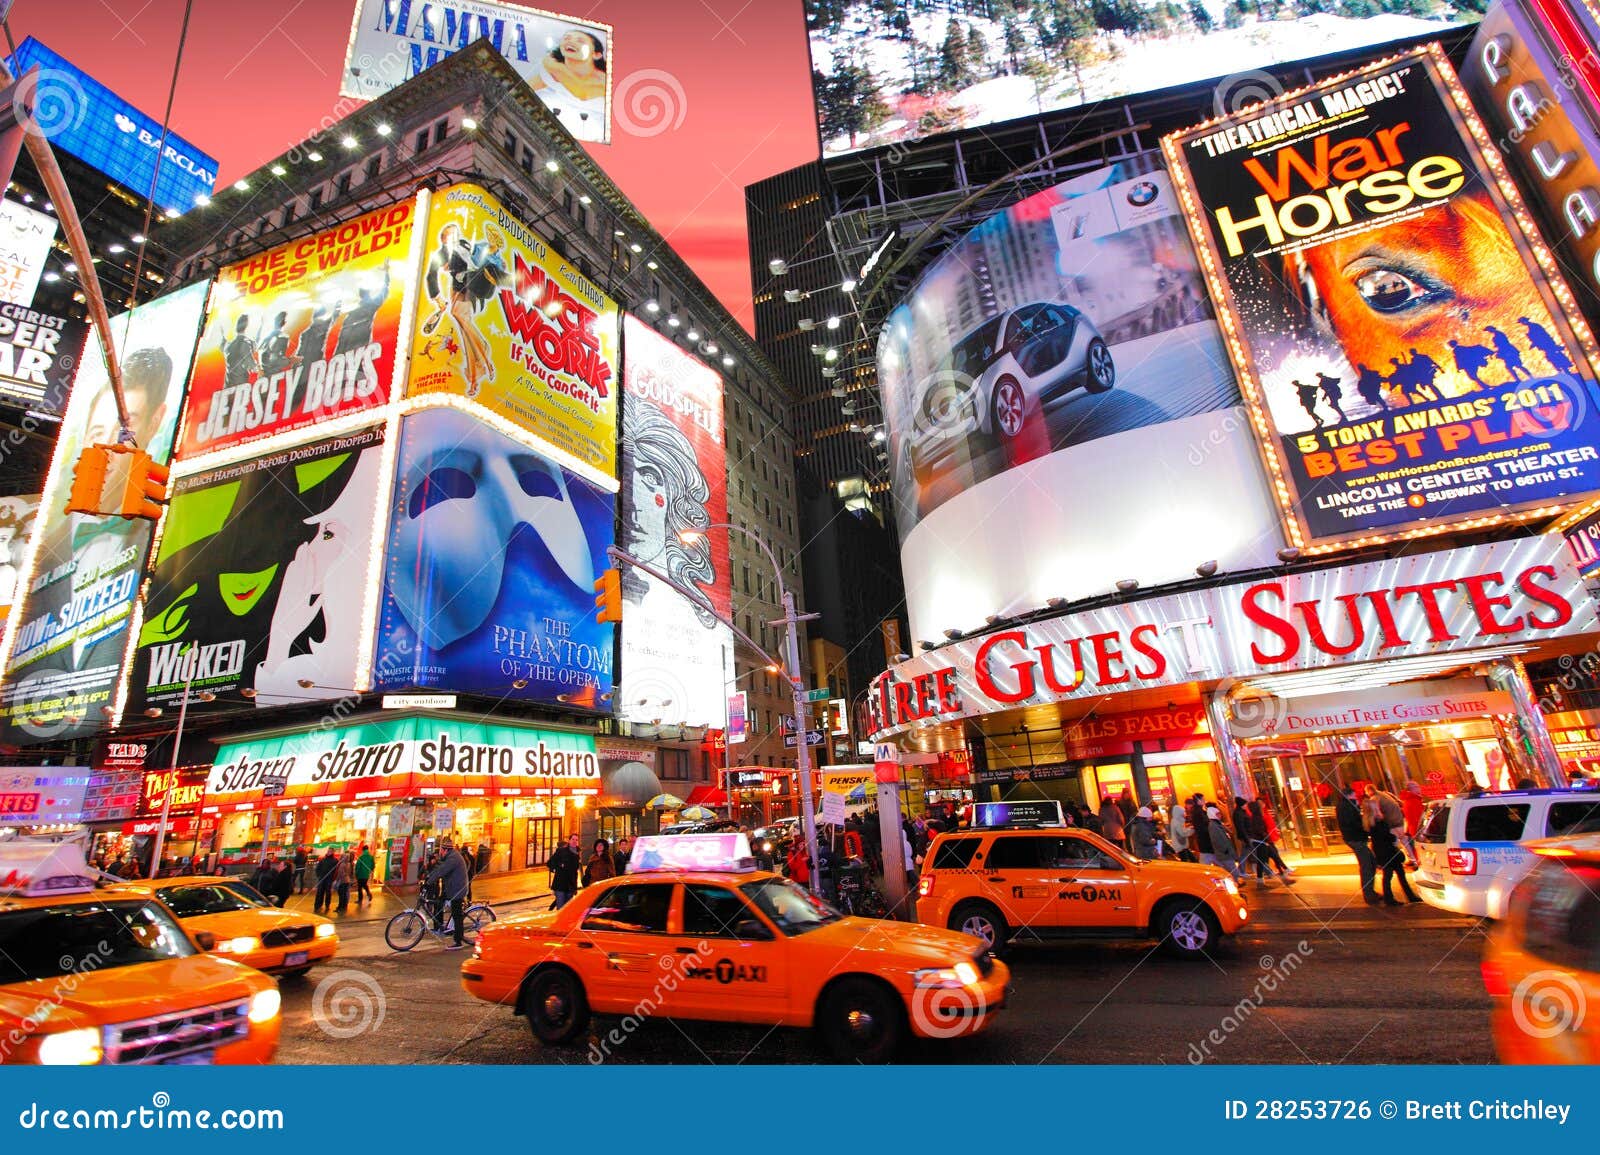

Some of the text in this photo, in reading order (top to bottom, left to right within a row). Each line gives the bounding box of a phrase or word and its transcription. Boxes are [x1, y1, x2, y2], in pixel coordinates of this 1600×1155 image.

[374, 0, 530, 62] MAMMA
[1242, 121, 1412, 203] War
[294, 204, 410, 261] CROWD
[498, 208, 546, 262] BRODERICK
[1215, 154, 1465, 257] Horse
[235, 260, 308, 298] GOES
[515, 251, 601, 351] NICE
[2, 304, 67, 331] CHRIST
[499, 289, 612, 398] WORK
[196, 342, 382, 442] JERSEY BOYS
[510, 343, 600, 415] If You Can Get It
[1297, 433, 1320, 453] 5
[1323, 420, 1385, 448] TONY
[1501, 384, 1565, 412] 2011
[1302, 402, 1572, 479] BEST PLAY
[214, 463, 257, 483] HAPPENED
[257, 455, 288, 471] BEFORE
[289, 443, 332, 462] DOROTHY
[333, 433, 367, 450] DROPPED
[1316, 446, 1599, 510] LINCOLN CENTER THEATER
[1345, 442, 1552, 488] www.WarHorseOnBroadway.com
[1339, 502, 1377, 519] TAKE
[1378, 496, 1408, 511] THE
[1425, 483, 1489, 503] SUBWAY
[1490, 479, 1513, 491] TO
[1515, 472, 1556, 488] 66TH
[1557, 466, 1584, 480] ST.
[57, 568, 139, 633] SUCCEED
[543, 617, 571, 638] THE
[1240, 564, 1574, 666] SUITES
[493, 624, 611, 675] PHANTOM
[500, 658, 601, 690] OF THE OPERA
[974, 615, 1214, 703] GUEST
[1392, 702, 1442, 719] GUEST
[1443, 699, 1488, 714] SUITES
[215, 735, 595, 793] sbarro sbarro sbarro sbarro
[829, 776, 870, 785] PENSKE
